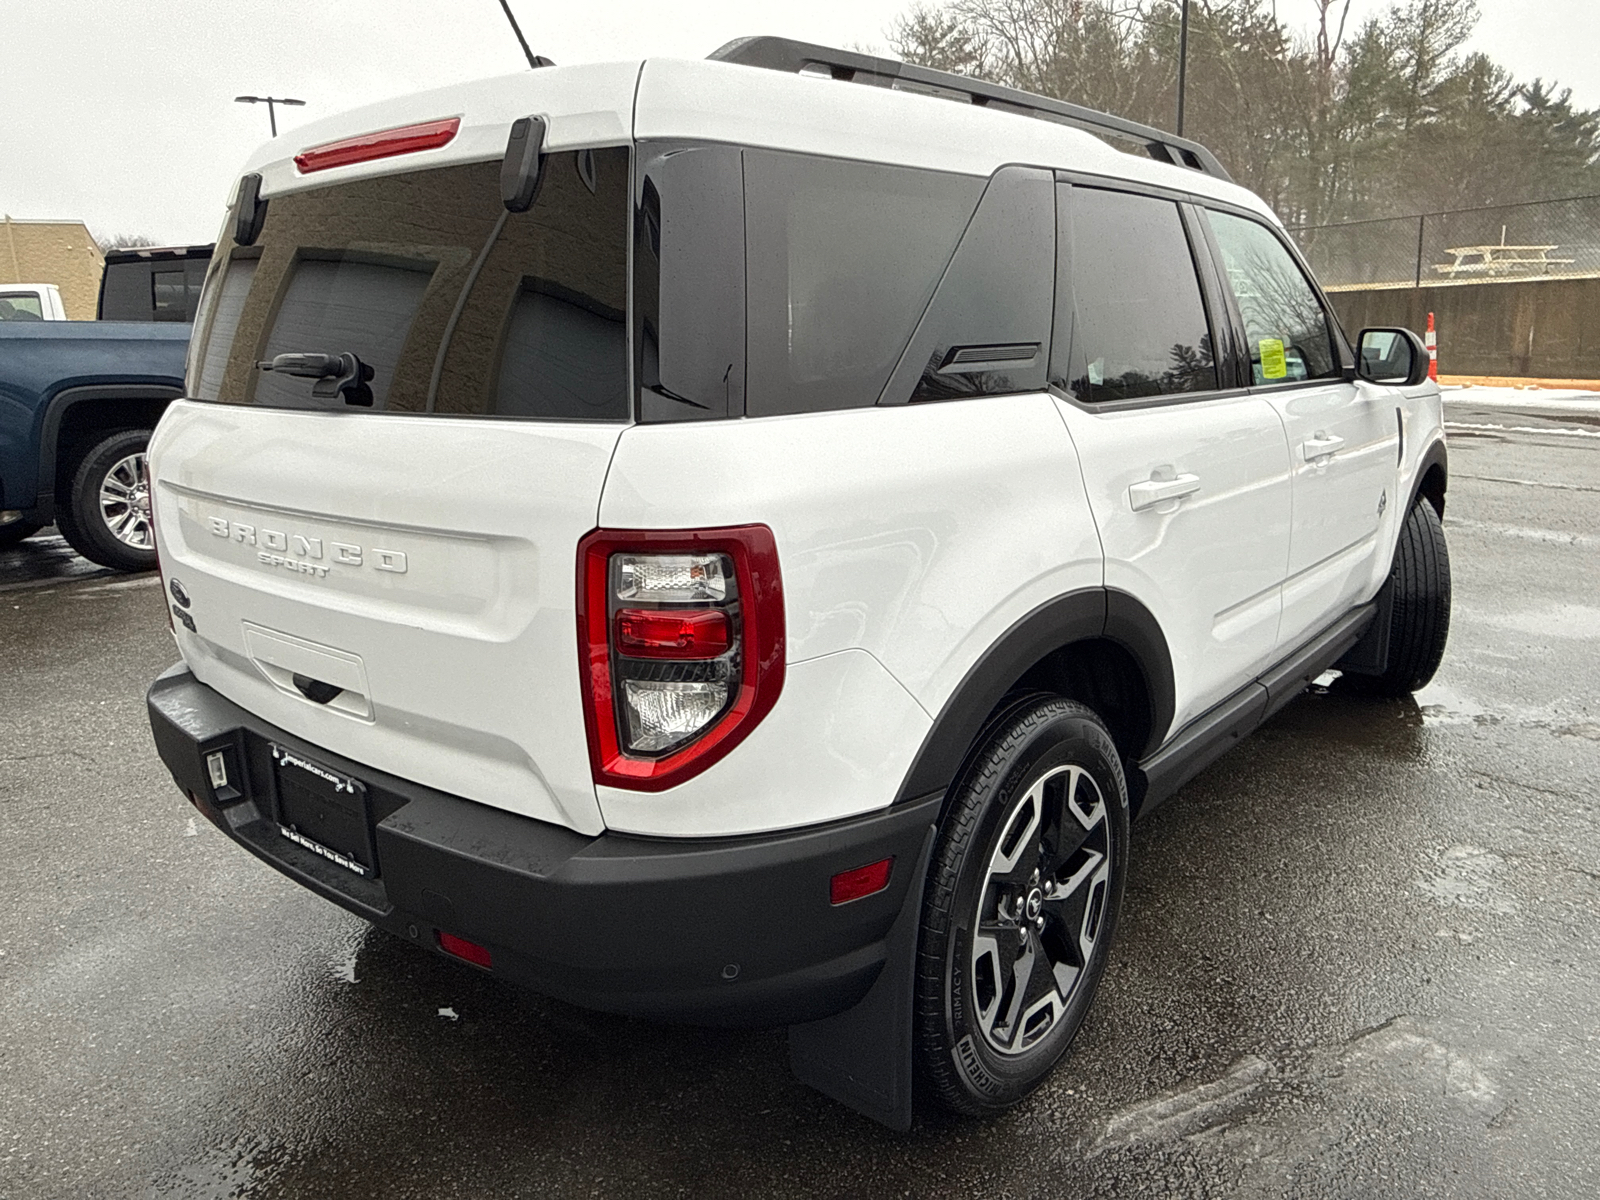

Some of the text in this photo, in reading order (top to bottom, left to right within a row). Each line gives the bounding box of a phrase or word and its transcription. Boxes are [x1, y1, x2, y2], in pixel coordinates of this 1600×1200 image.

[207, 515, 409, 575] BRONCO
[257, 551, 331, 577] SPORT
[1101, 738, 1129, 805] MICHELIN
[953, 967, 963, 1027] PRIMACY
[960, 1040, 1002, 1095] MICHELIN
